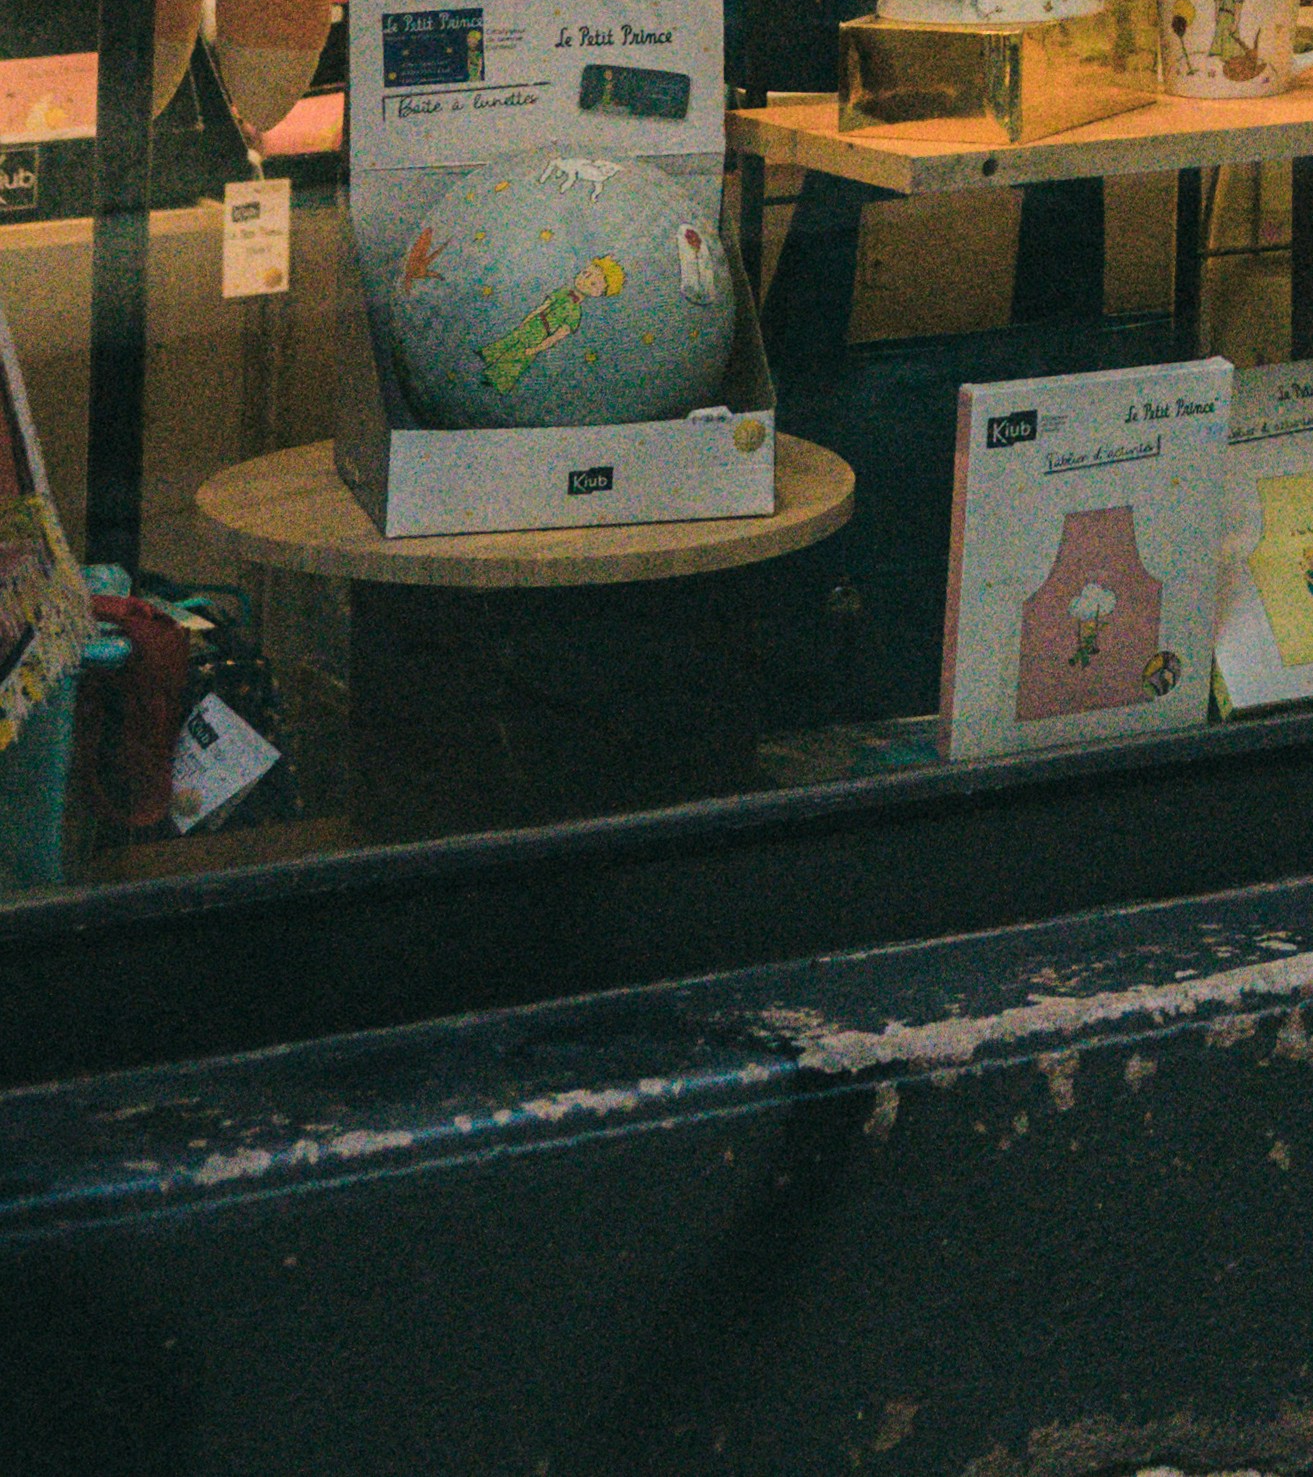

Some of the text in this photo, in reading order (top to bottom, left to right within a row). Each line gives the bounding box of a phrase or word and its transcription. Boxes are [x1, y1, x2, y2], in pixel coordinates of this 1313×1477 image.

[578, 24, 615, 47] Petit
[620, 22, 674, 46] Prince
[1141, 399, 1171, 420] Petit
[1174, 397, 1216, 419] Prince
[991, 420, 1032, 445] Kiub
[573, 472, 608, 491] Kiub
